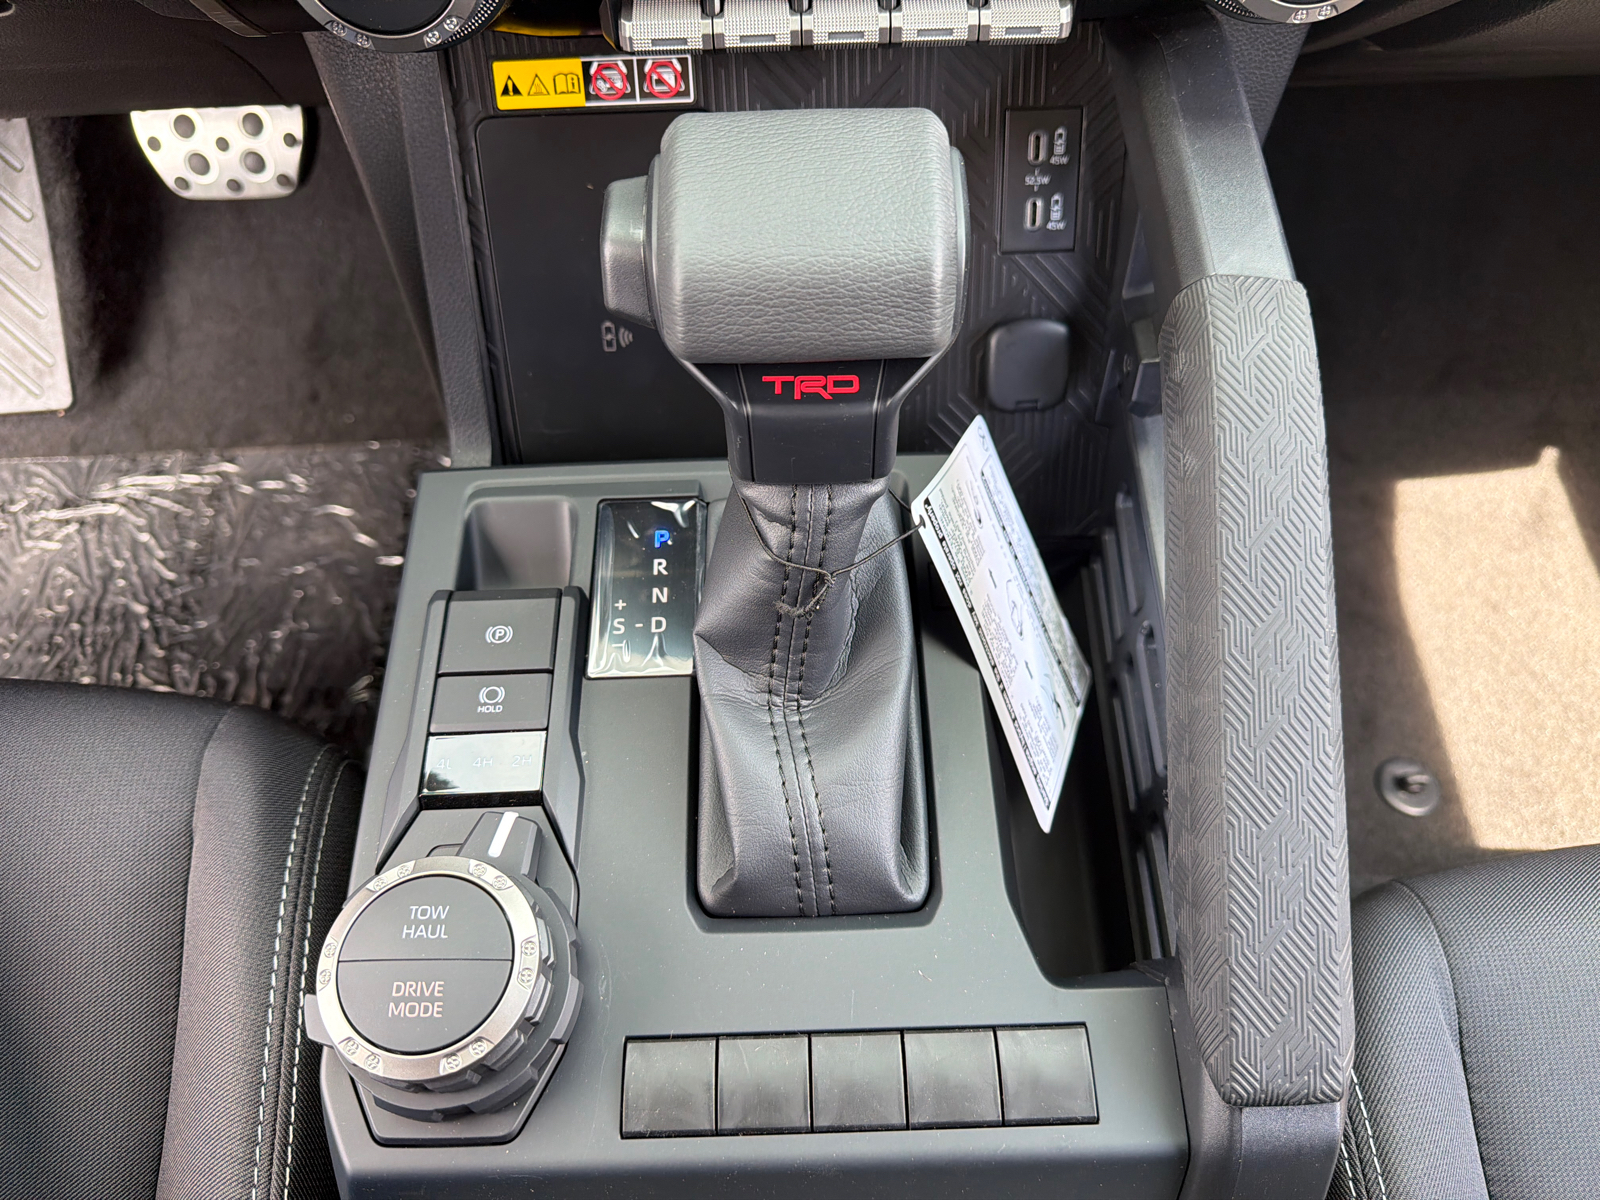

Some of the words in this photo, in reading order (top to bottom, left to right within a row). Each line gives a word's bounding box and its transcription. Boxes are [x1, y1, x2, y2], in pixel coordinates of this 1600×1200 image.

[1049, 155, 1070, 165] 45W
[1046, 220, 1067, 231] 45W
[762, 375, 859, 400] TRD
[654, 530, 670, 548] P
[653, 558, 668, 576] R
[652, 587, 668, 603] N
[612, 617, 626, 635] S
[651, 616, 667, 633] D
[477, 705, 503, 713] HOLD
[472, 757, 493, 767] 4H
[512, 755, 532, 767] 2H
[409, 905, 449, 920] TOW
[402, 924, 448, 939] HAUL
[392, 981, 444, 997] DRIVE
[388, 1002, 443, 1018] MODE
